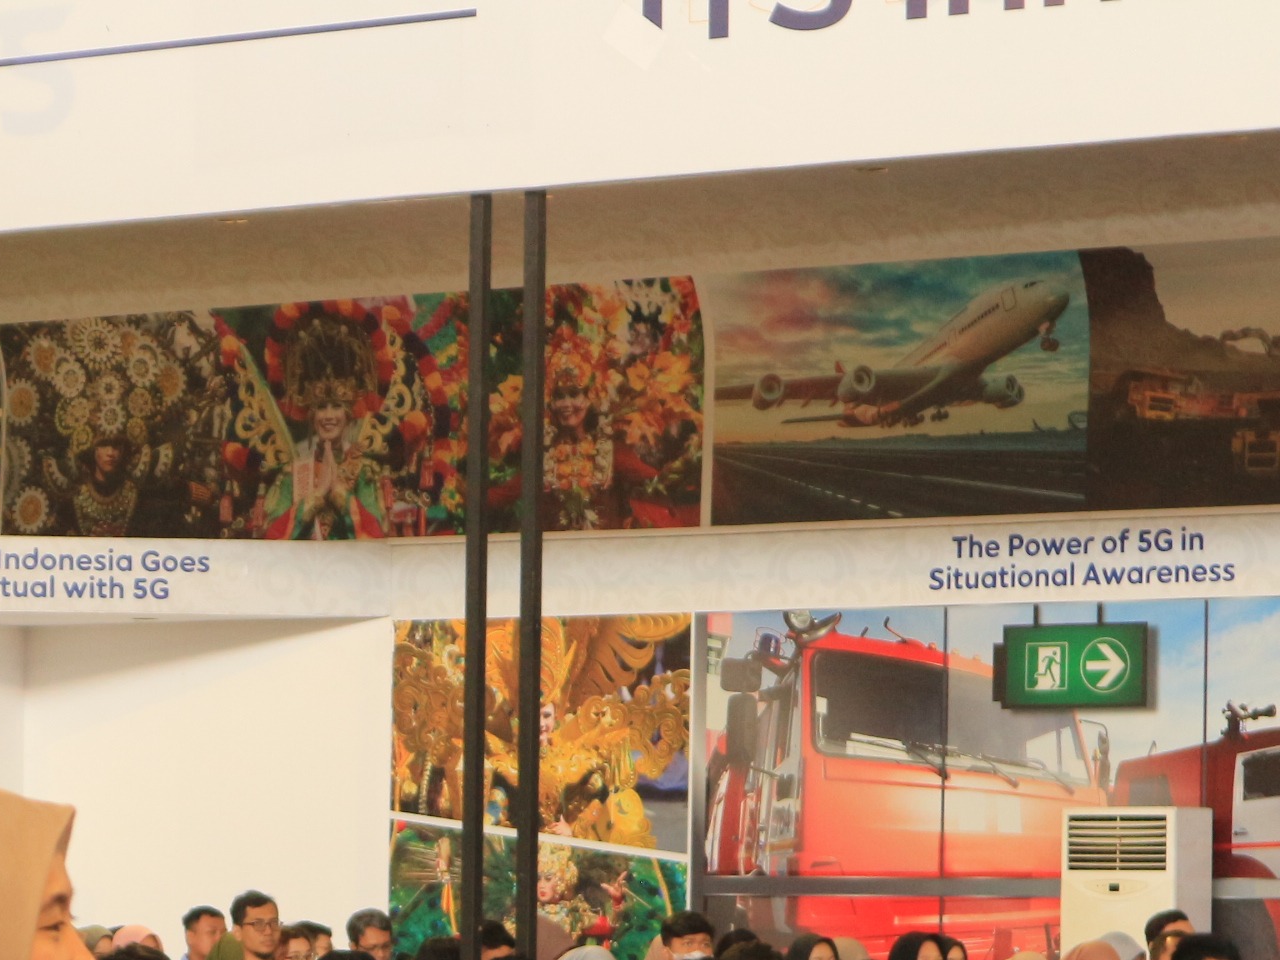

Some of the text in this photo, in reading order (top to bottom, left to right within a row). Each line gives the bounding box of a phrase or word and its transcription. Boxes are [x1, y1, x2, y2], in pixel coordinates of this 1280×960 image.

[952, 526, 1205, 558] The Power of 5G in
[141, 549, 210, 572] Goes
[63, 575, 124, 598] with
[133, 577, 170, 599] 5G
[929, 562, 1236, 590] Situational Awareness
